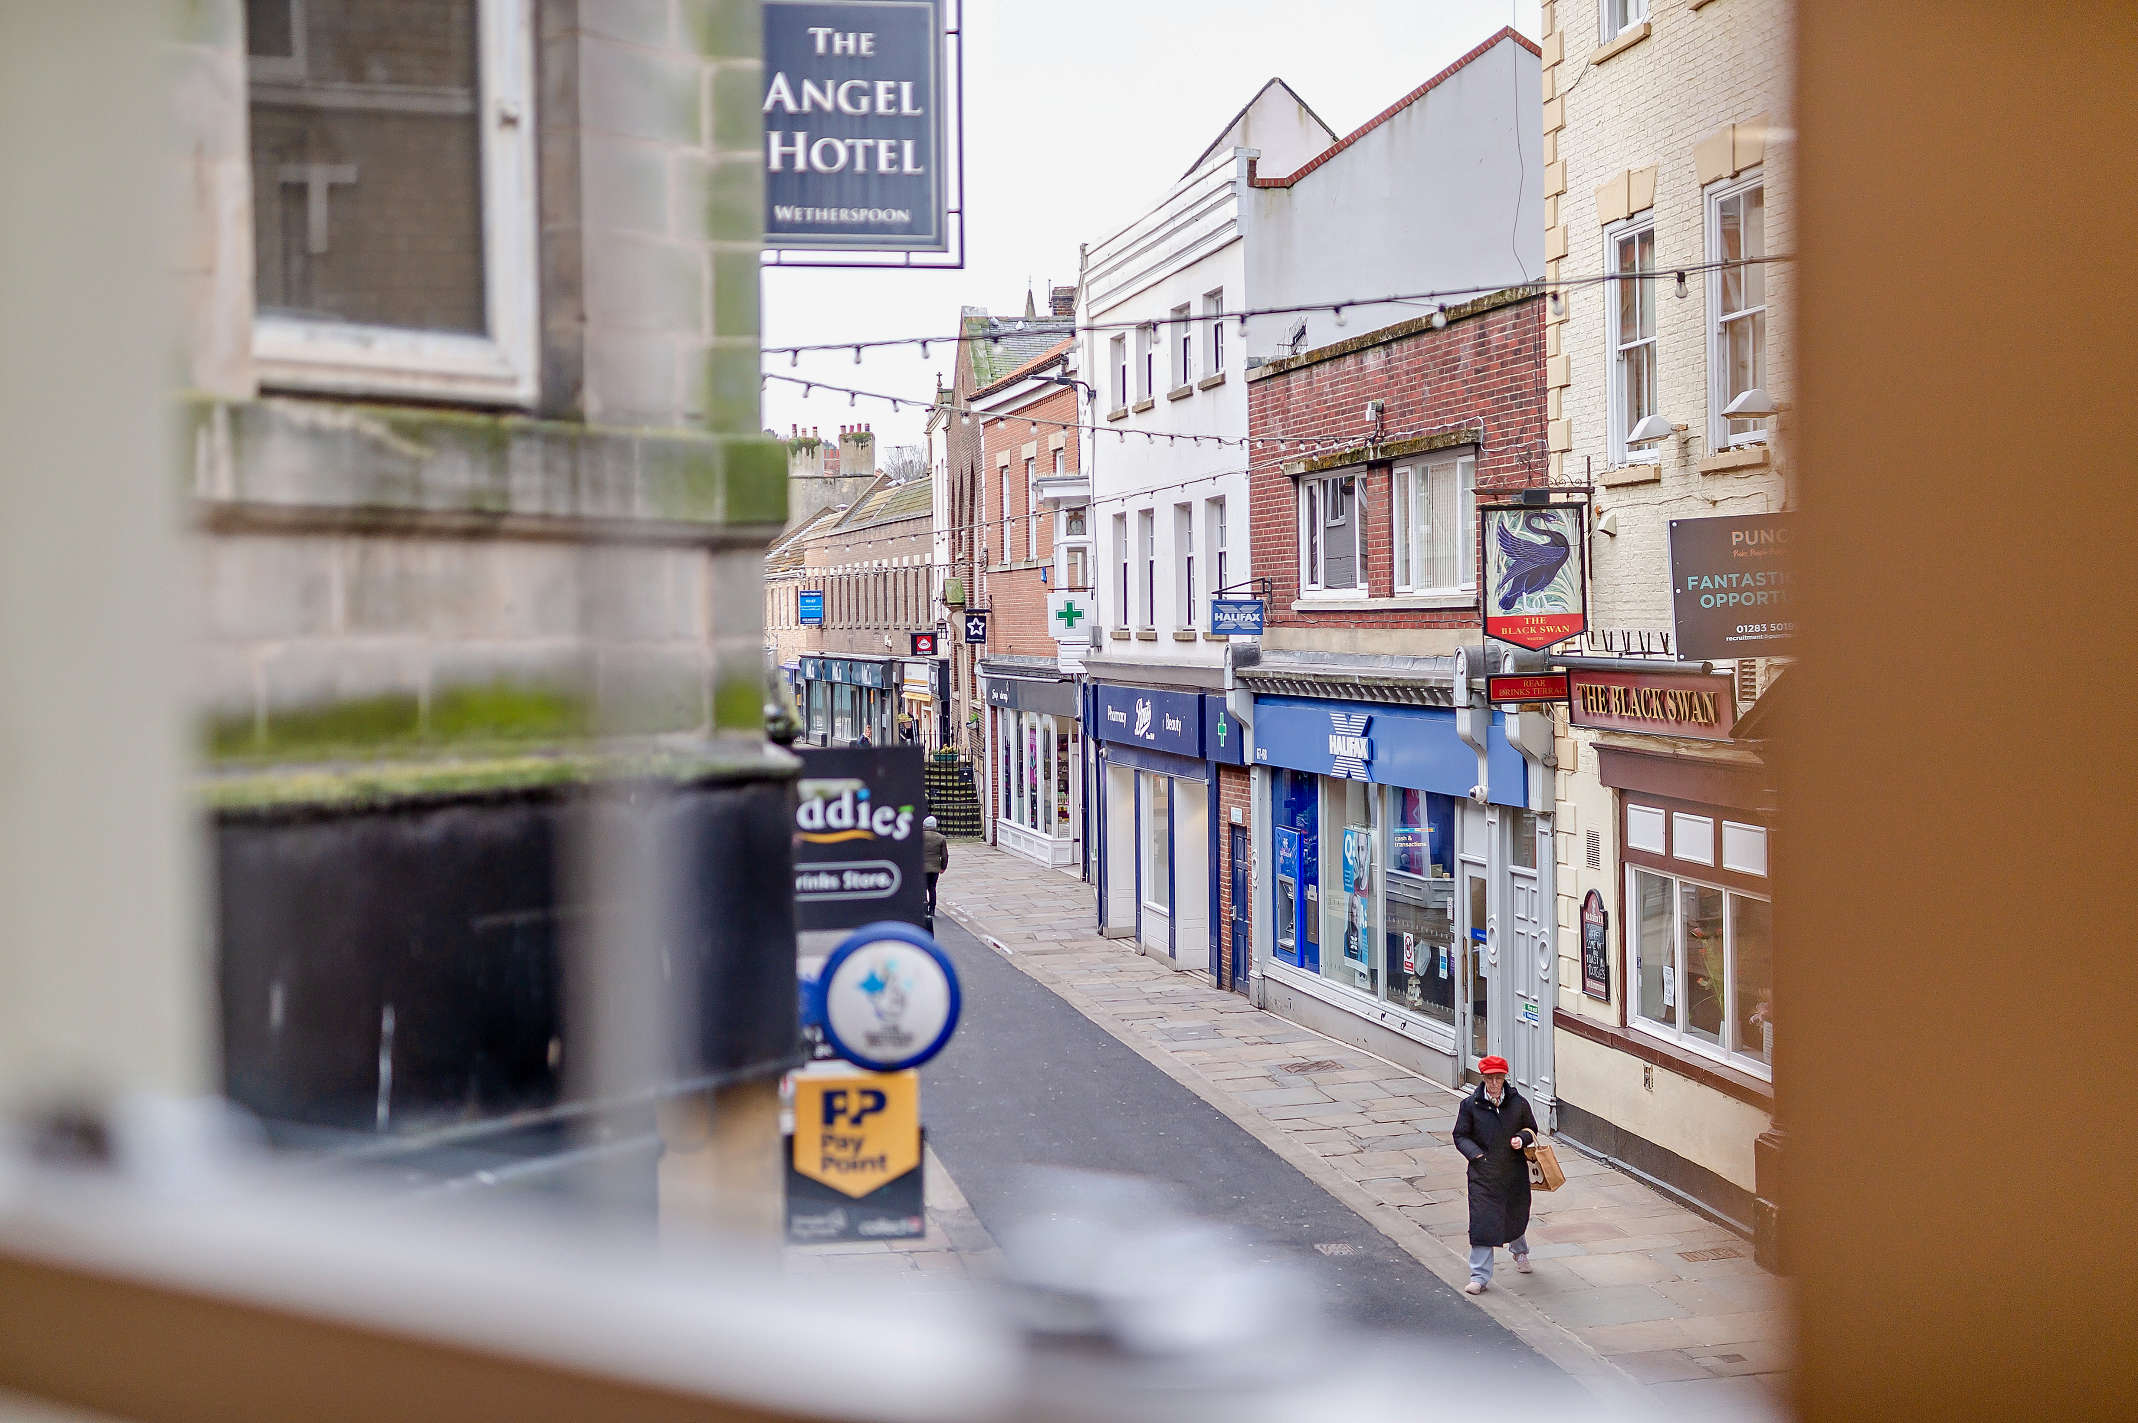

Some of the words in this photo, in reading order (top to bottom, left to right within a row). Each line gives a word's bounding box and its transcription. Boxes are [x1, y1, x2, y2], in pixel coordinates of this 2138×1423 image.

[763, 72, 924, 116] ANGEL
[766, 130, 925, 174] HOTEL
[774, 205, 911, 224] WETHERSPOON
[1214, 612, 1261, 622] HALIFAX
[1524, 617, 1547, 625] THE
[1501, 626, 1537, 635] BLACK
[1540, 624, 1570, 633] SWAN
[1736, 623, 1767, 634] 01283
[1532, 687, 1568, 695] TERRAC
[1576, 683, 1608, 714] THE
[1609, 685, 1665, 719] BLACK
[1666, 689, 1720, 725] SWAN
[1165, 712, 1182, 737] Beauty
[1328, 734, 1370, 761] HALIFAX
[822, 1134, 864, 1155] Pay
[822, 1156, 887, 1172] Point
